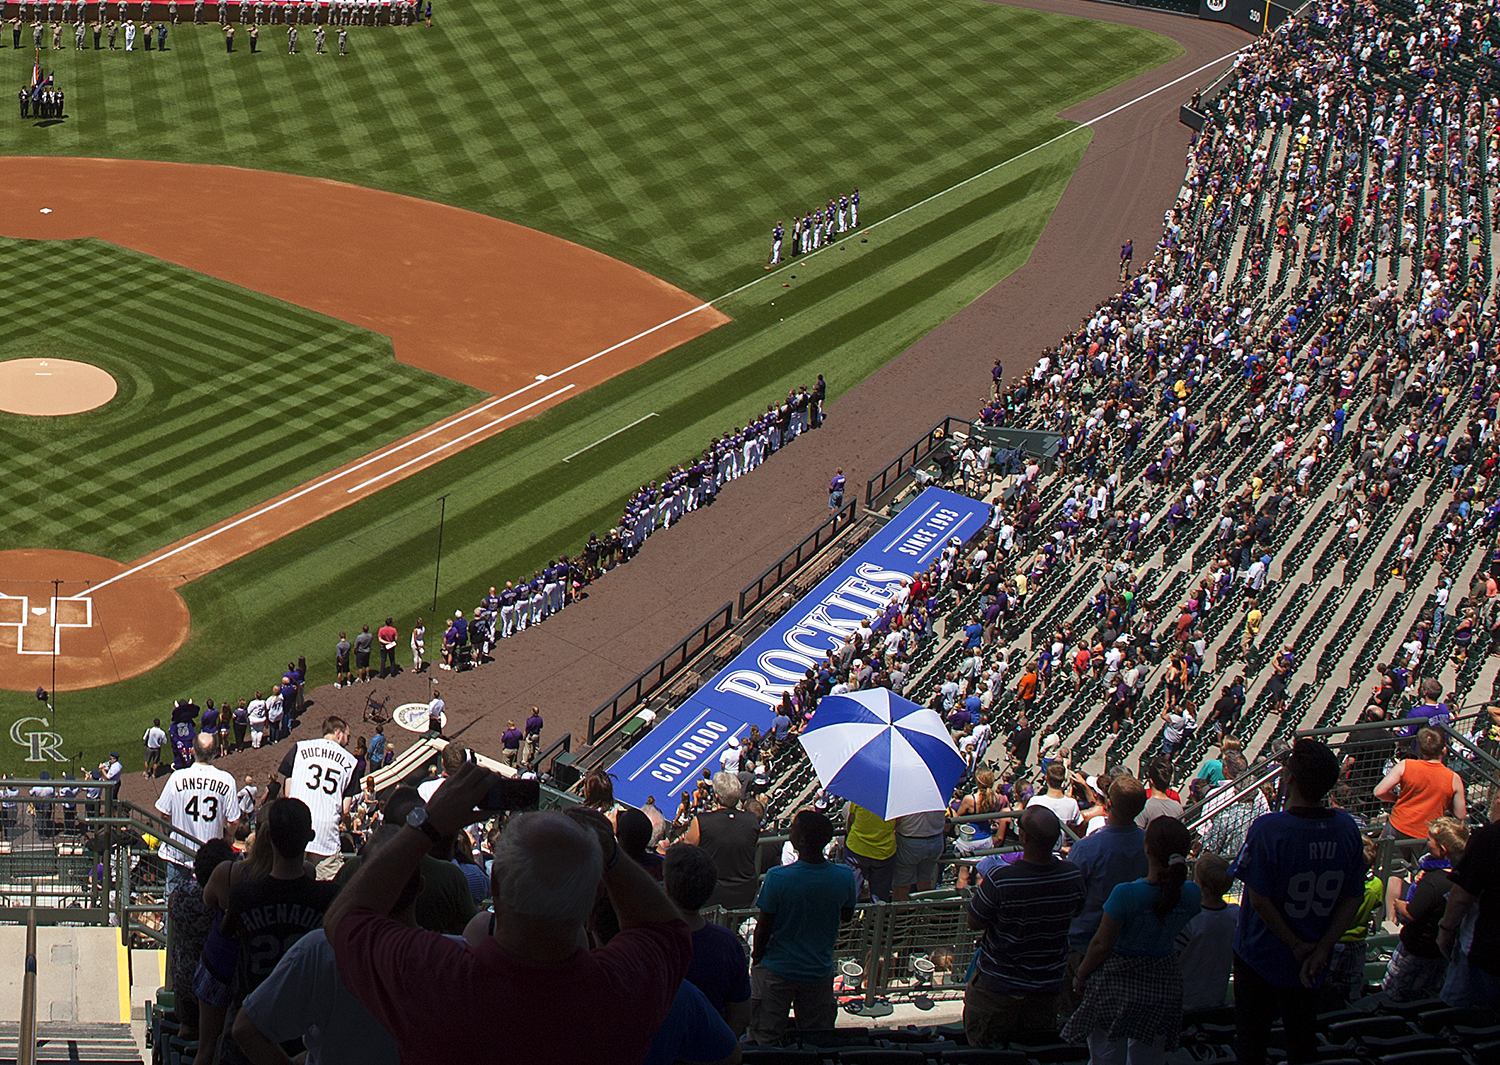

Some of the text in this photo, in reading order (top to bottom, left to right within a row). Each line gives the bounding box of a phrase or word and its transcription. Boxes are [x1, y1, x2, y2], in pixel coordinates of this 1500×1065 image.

[1249, 9, 1261, 22] 350
[898, 508, 960, 556] SINCE 1993
[714, 561, 916, 713] ROCKIES
[301, 746, 353, 773] BUCHHOLZ
[650, 720, 729, 783] COLORADO
[174, 777, 230, 796] LANSFORD
[305, 763, 341, 796] 35
[184, 795, 218, 822] 43
[1308, 841, 1338, 860] RYU
[1284, 870, 1345, 919] 99
[240, 903, 325, 932] ARENADO
